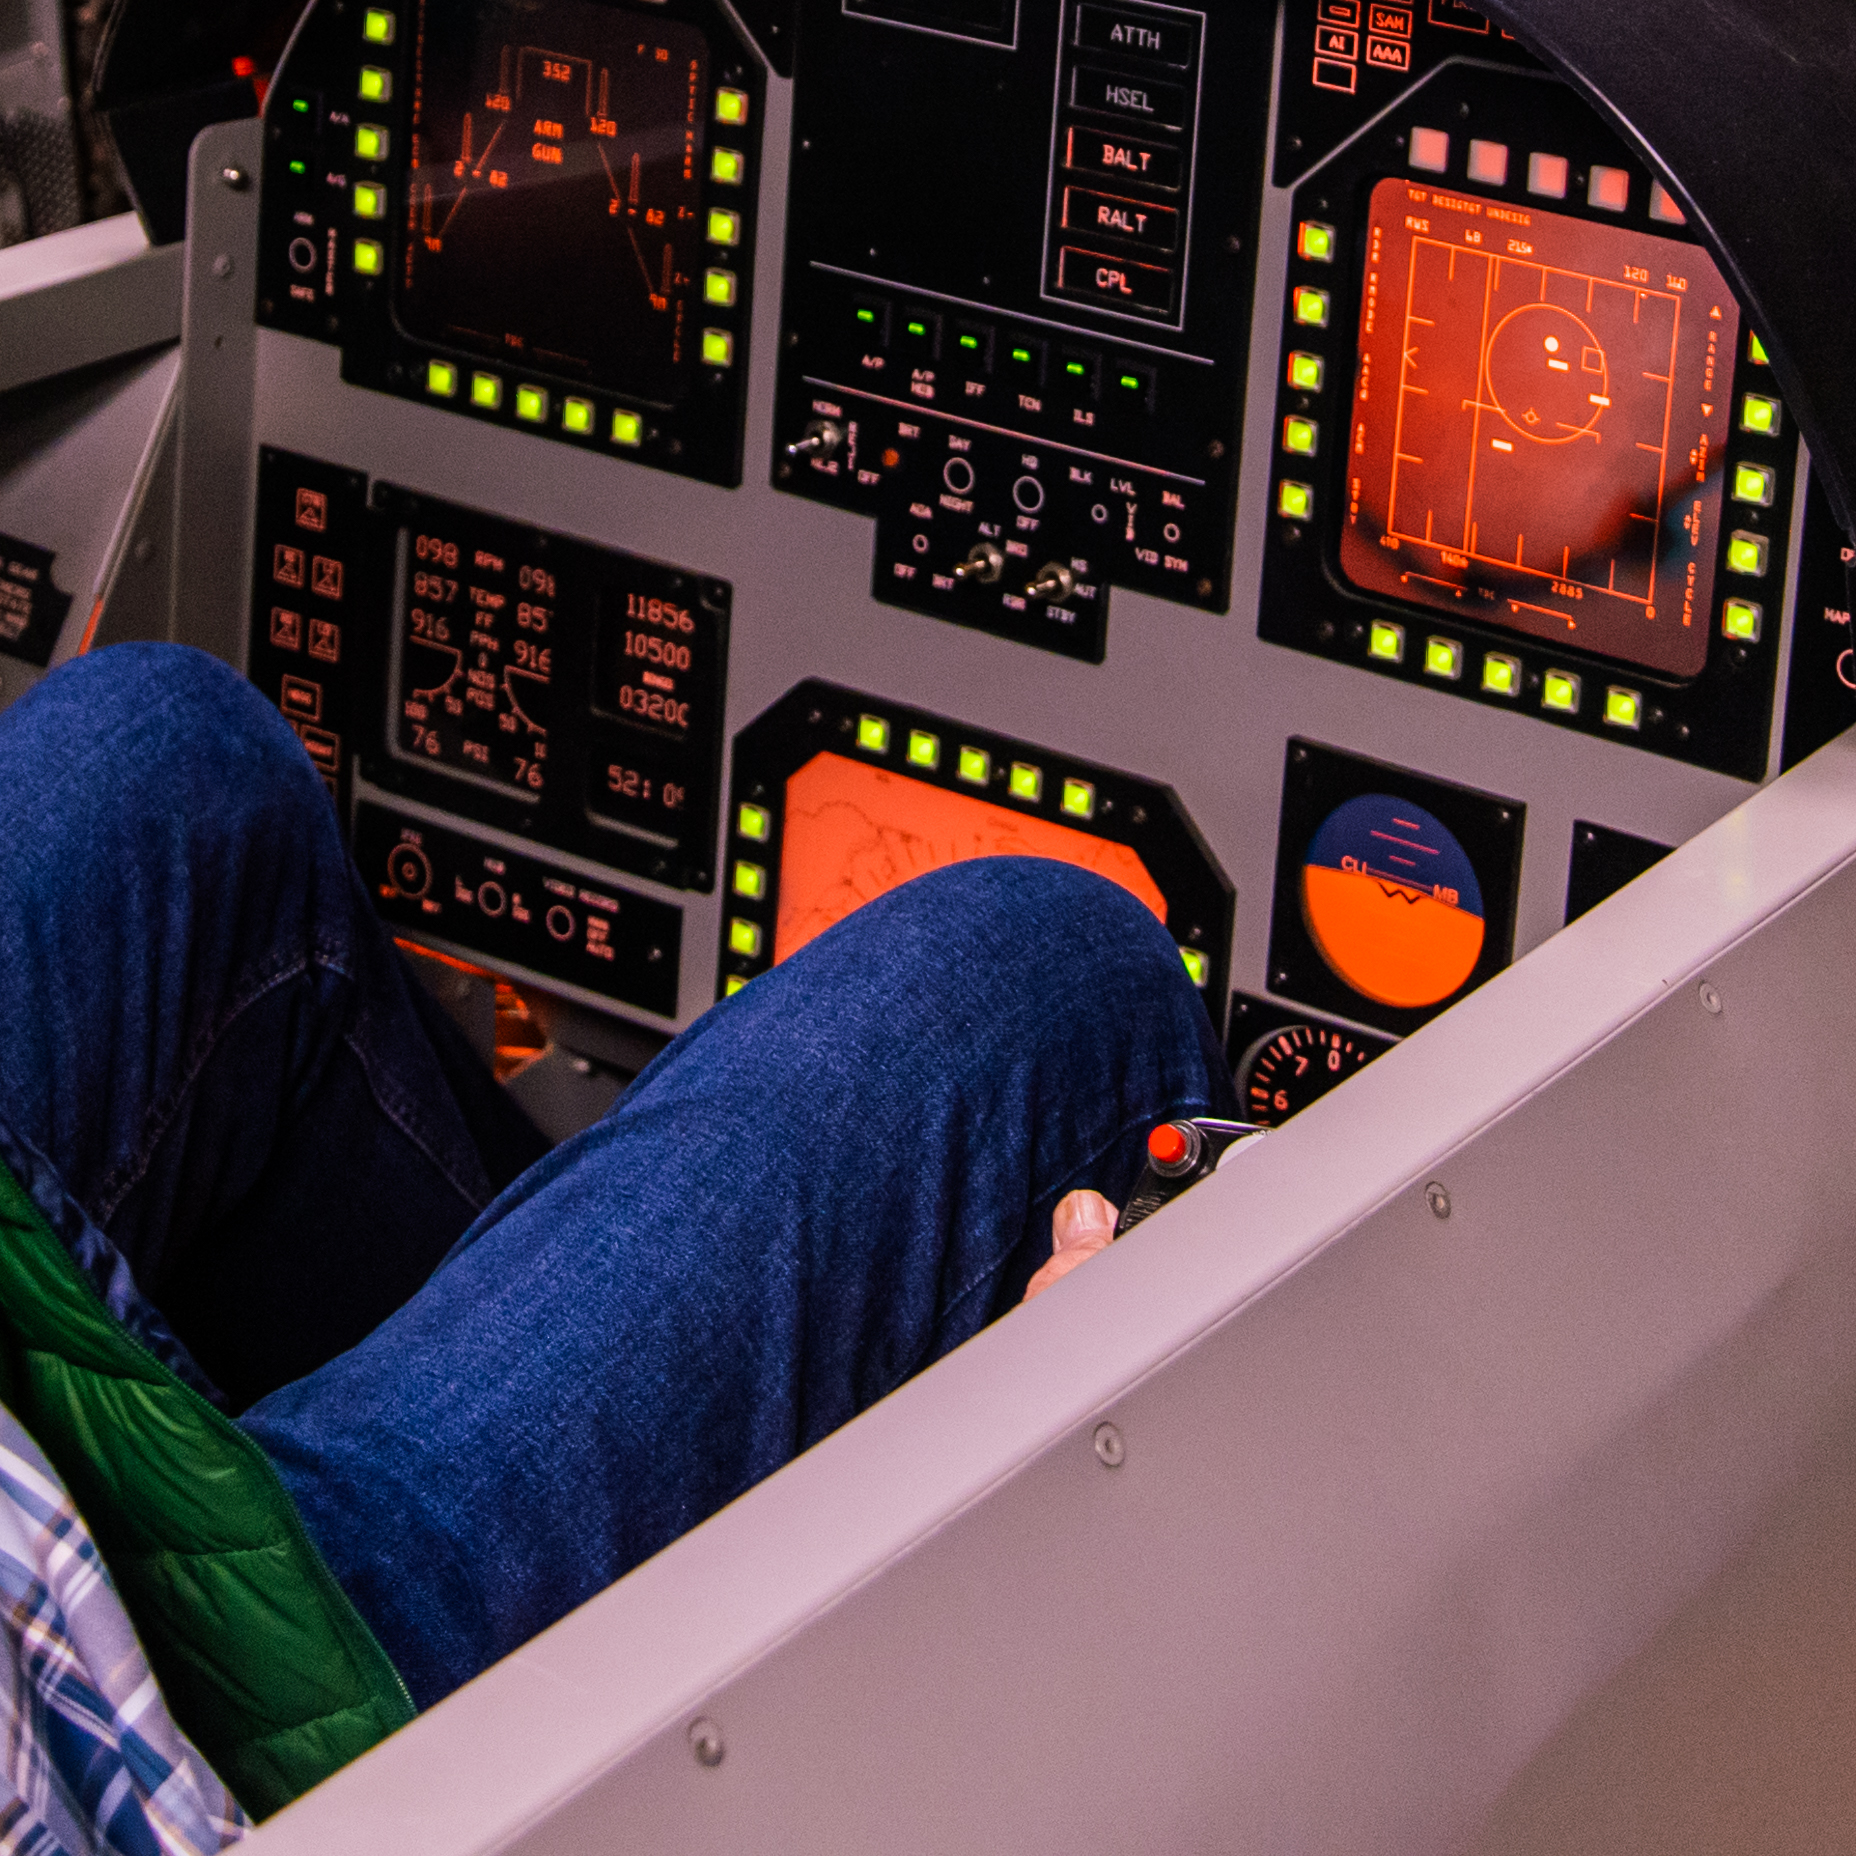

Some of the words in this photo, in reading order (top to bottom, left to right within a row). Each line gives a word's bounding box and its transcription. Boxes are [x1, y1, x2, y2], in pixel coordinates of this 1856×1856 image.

[1375, 12, 1404, 32] SAM
[1110, 24, 1162, 50] ATTH
[1328, 34, 1345, 52] AI
[1372, 44, 1403, 64] AAA
[543, 61, 572, 83] 352
[1106, 84, 1155, 113] HSEL
[533, 119, 564, 140] ARM
[532, 143, 564, 165] GUN
[1102, 144, 1152, 172] BALT
[1097, 206, 1148, 234] RALT
[1404, 214, 1430, 234] RWS
[1095, 268, 1133, 294] CPL
[1623, 264, 1650, 284] 120
[1703, 330, 1718, 392] RANGE
[1068, 465, 1093, 485] BLK
[1110, 477, 1136, 496] LVL
[1161, 490, 1186, 510] BAL
[978, 521, 1002, 538] ALT
[415, 534, 460, 570] 098
[413, 571, 459, 603] 857
[469, 585, 506, 610] TEMP
[517, 601, 554, 634] 85
[626, 592, 695, 634] 11856
[410, 607, 451, 642] 916
[1046, 605, 1077, 625] STBY
[624, 630, 691, 671] 10500
[411, 723, 441, 756] 76
[514, 756, 544, 789] 76
[1295, 1055, 1309, 1076] 7
[1327, 1049, 1341, 1072] 0
[1273, 1089, 1289, 1112] 6
